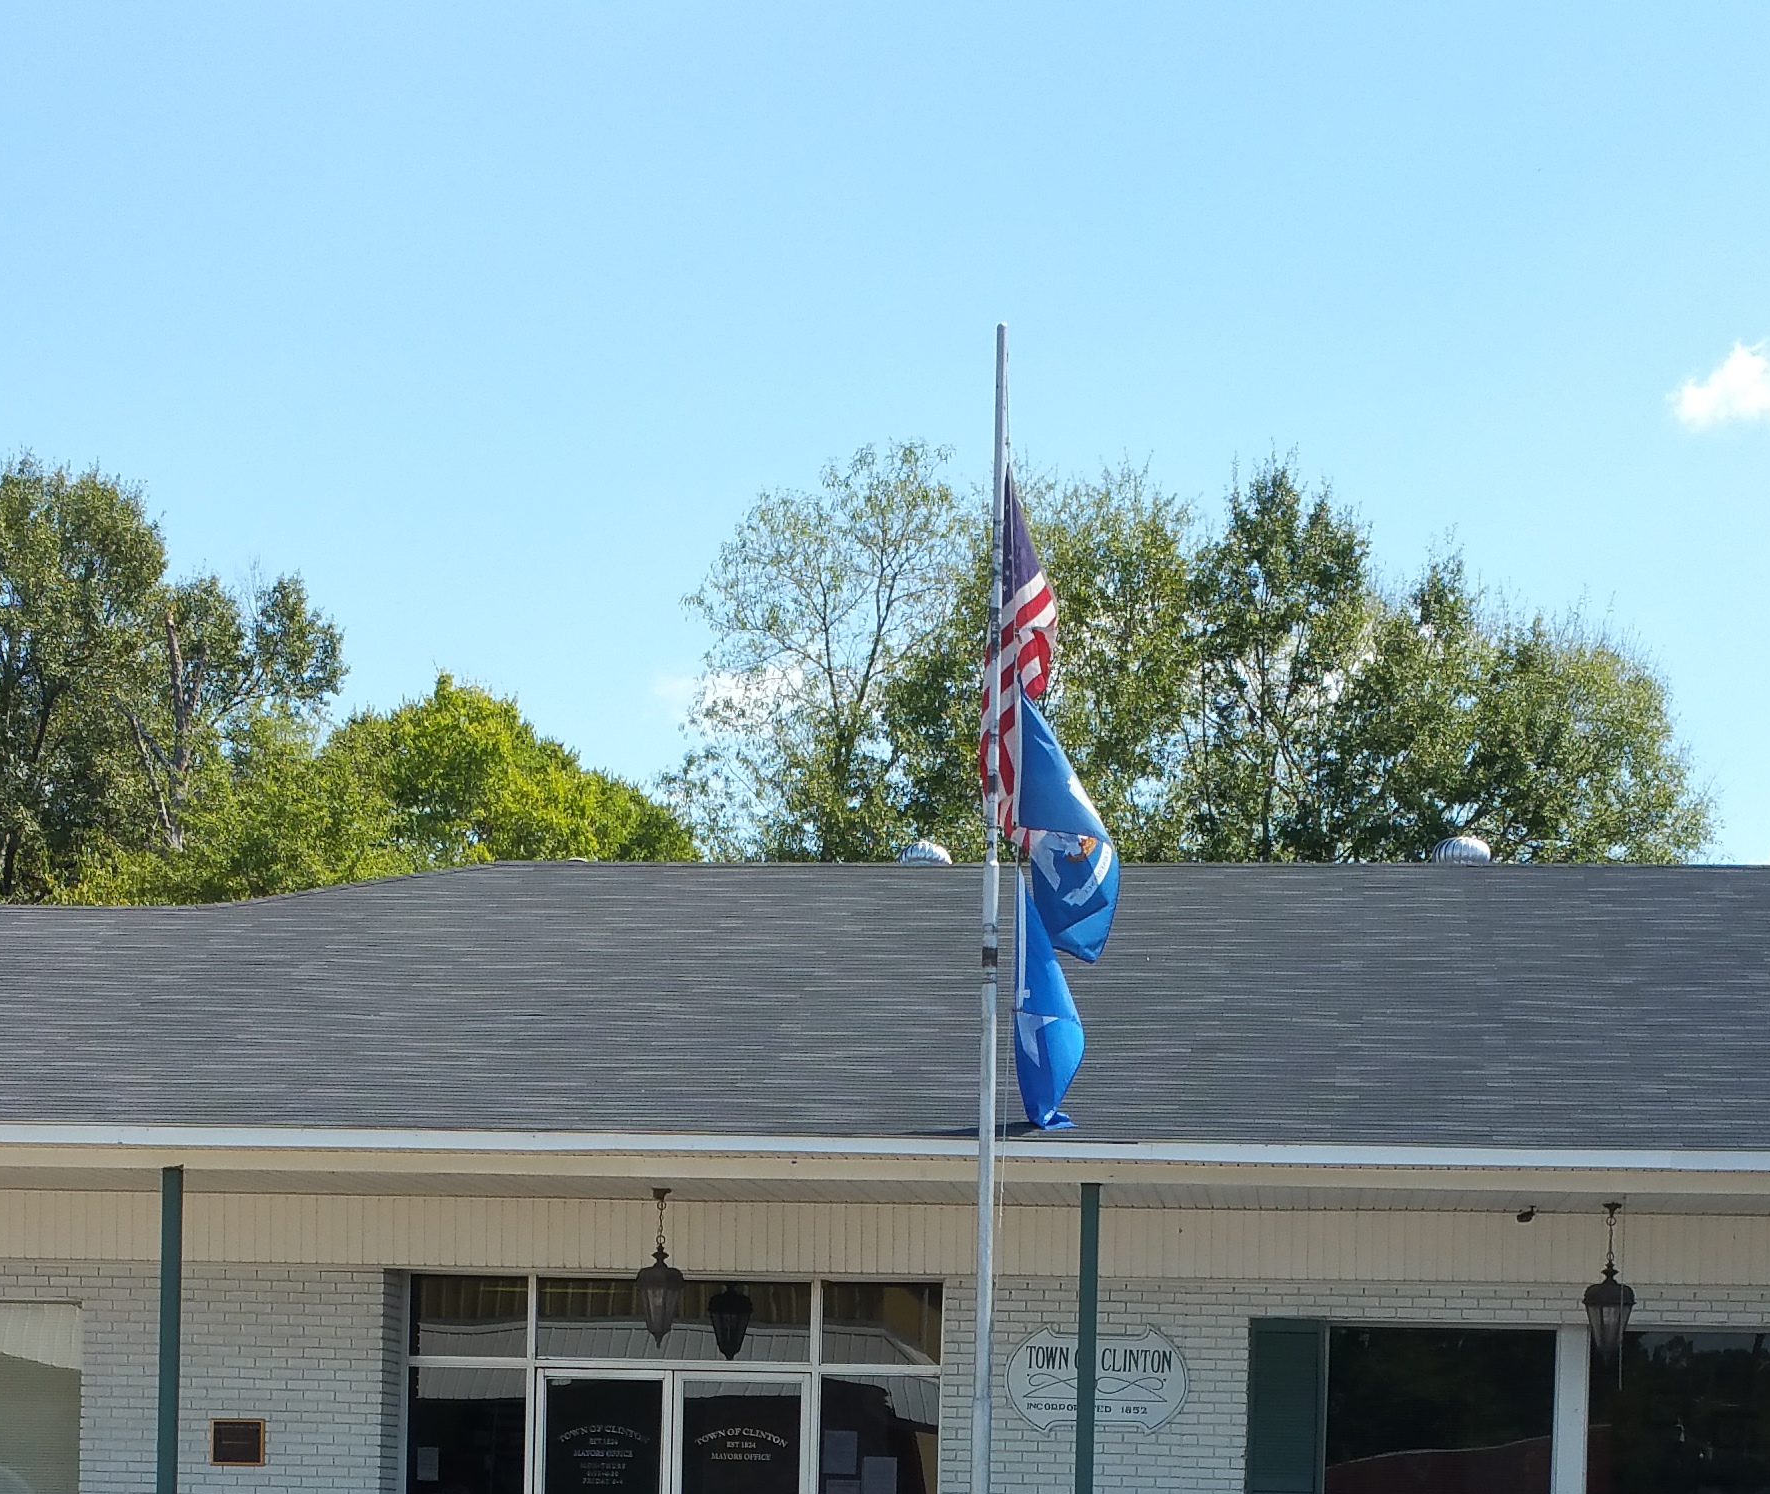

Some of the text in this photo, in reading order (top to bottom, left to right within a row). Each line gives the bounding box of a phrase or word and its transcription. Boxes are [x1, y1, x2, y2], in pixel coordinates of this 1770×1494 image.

[1026, 1346, 1069, 1370] TOWN
[1101, 1348, 1173, 1373] CLINTON
[1121, 1406, 1148, 1414] 1852
[559, 1426, 588, 1442] TOWN
[605, 1425, 649, 1443] CLINTON
[695, 1428, 789, 1448] TOWN OF CLINTON
[711, 1452, 771, 1461] MAYORS OFFICE
